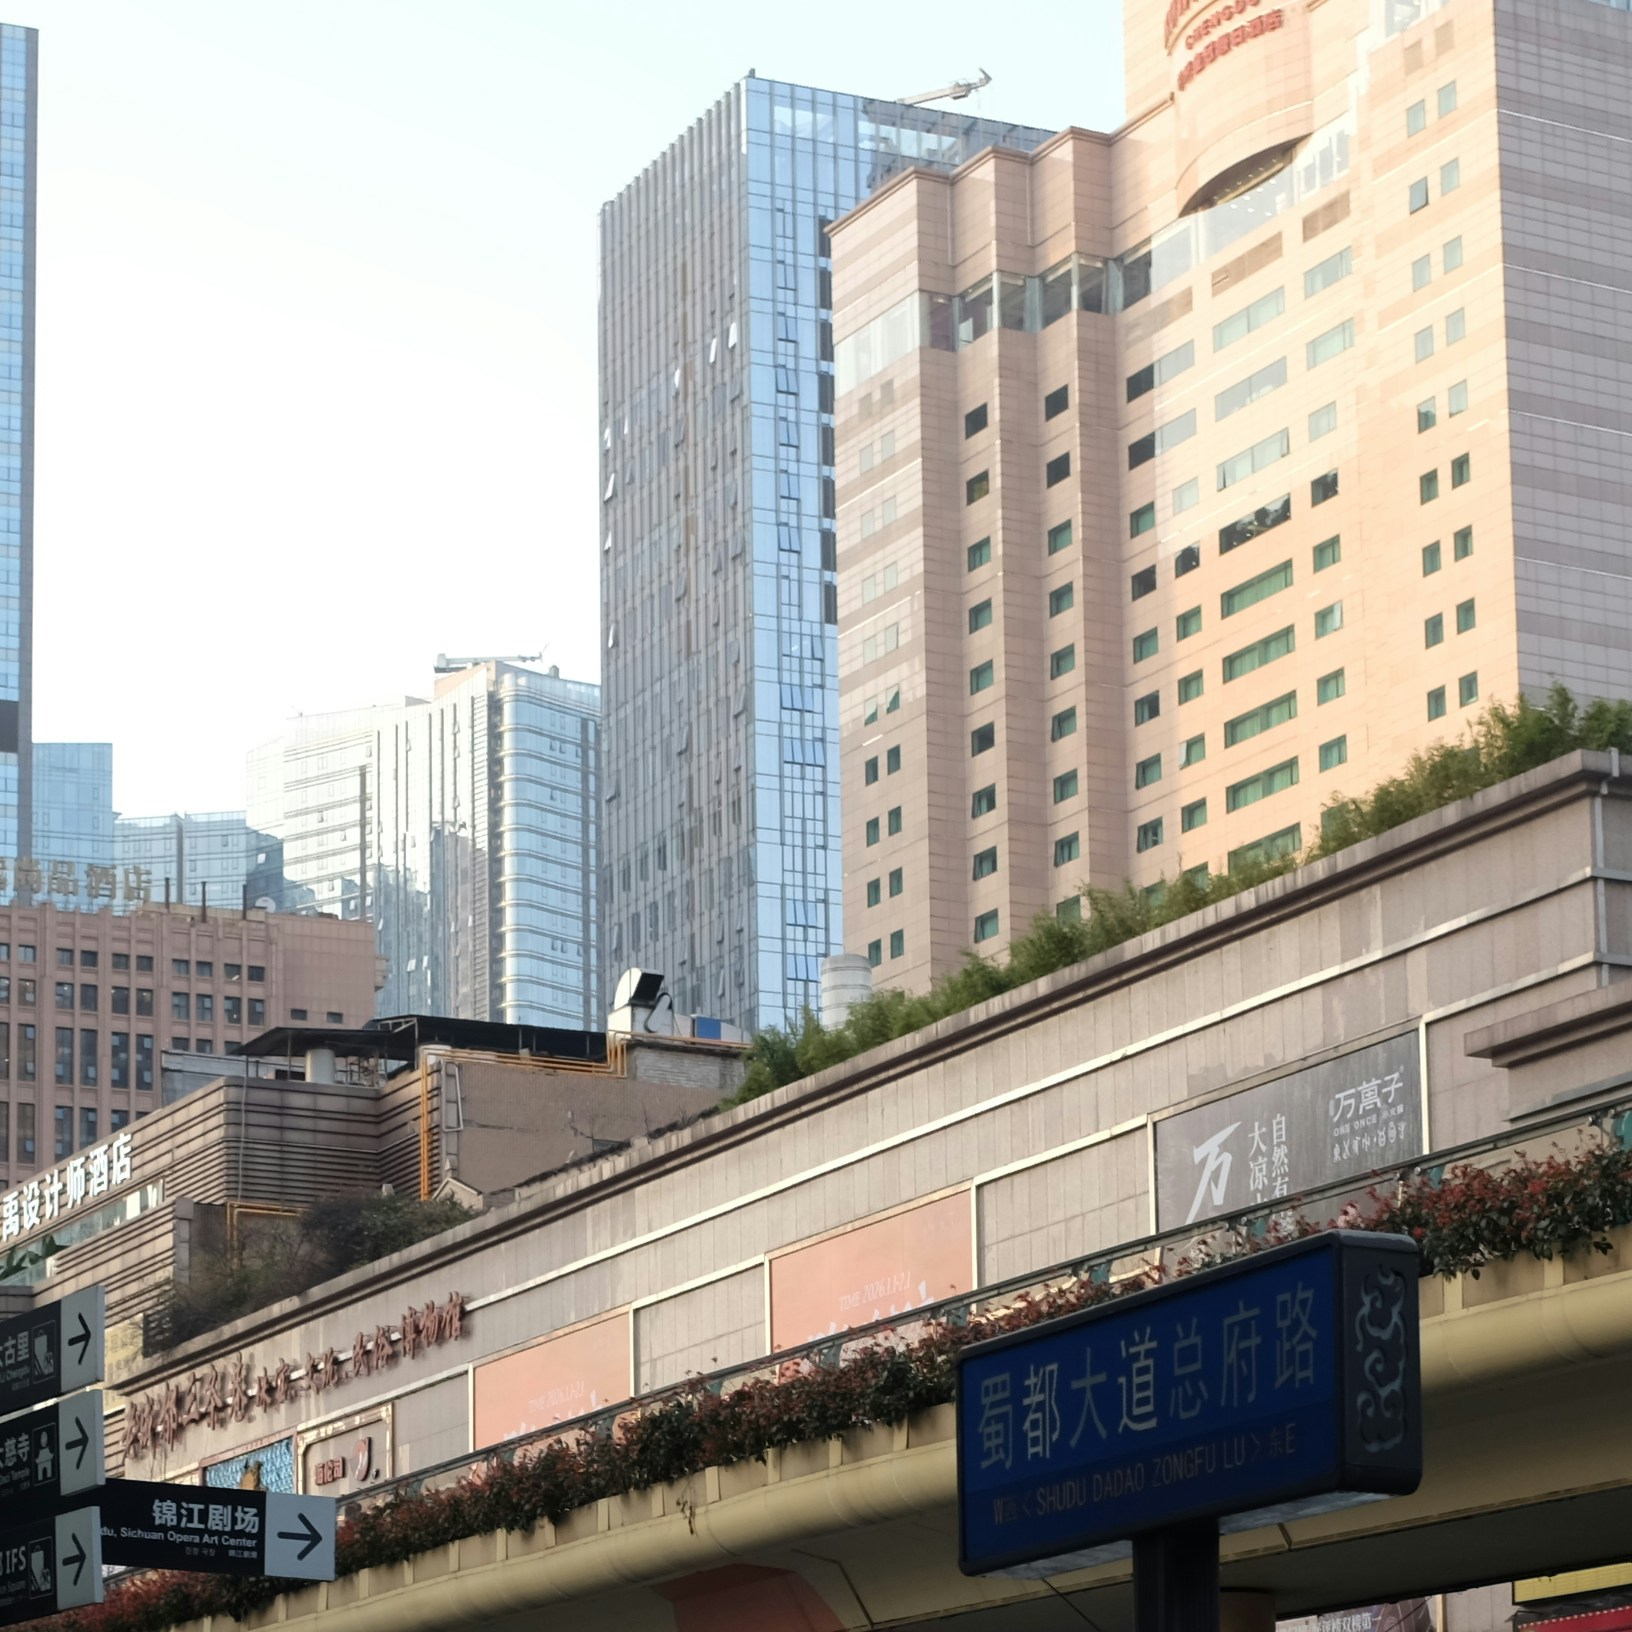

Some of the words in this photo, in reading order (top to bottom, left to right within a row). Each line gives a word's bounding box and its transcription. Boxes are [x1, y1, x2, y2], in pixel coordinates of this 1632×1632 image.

[977, 1280, 1318, 1470] 蜀都大道总府路
[1036, 1477, 1086, 1516] SHUDU
[1092, 1463, 1145, 1498] DADAO
[1152, 1443, 1217, 1488] ZONGFU
[1223, 1437, 1245, 1469] LU
[152, 1499, 260, 1534] 锦江剧场
[120, 1526, 164, 1541] Sichuan
[167, 1530, 201, 1544] Opera
[202, 1533, 219, 1546] Art
[221, 1535, 257, 1548] Center
[5, 1546, 27, 1575] IFS
